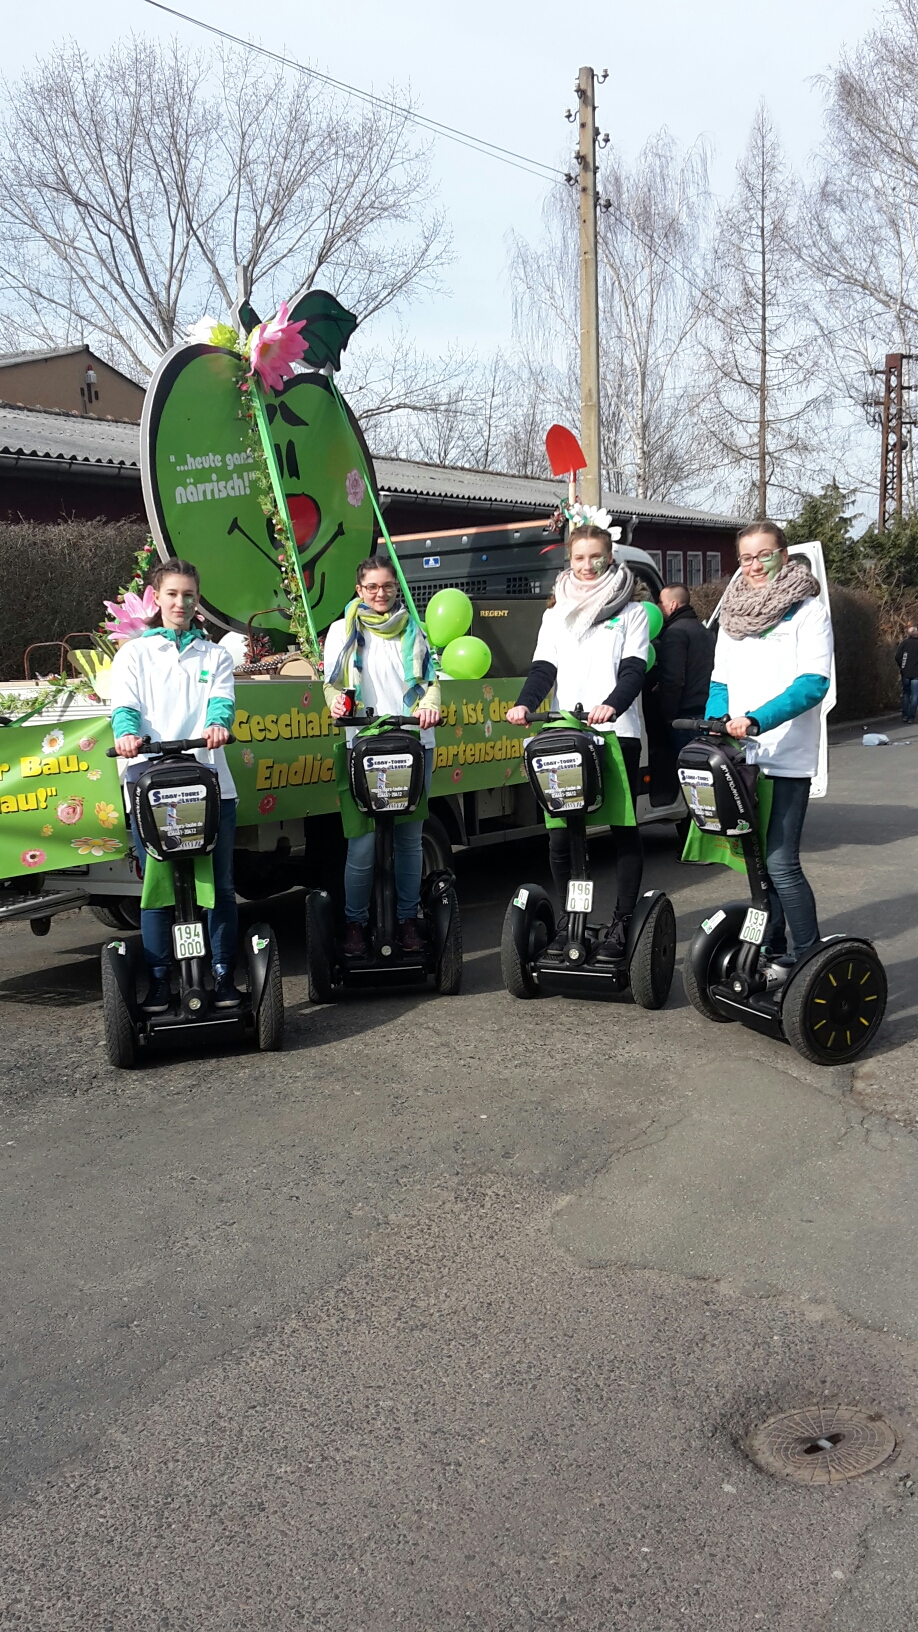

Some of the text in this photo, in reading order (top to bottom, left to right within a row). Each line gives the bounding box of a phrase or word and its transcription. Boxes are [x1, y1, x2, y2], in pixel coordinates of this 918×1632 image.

[175, 471, 256, 504] närrisch!"
[479, 609, 509, 617] REGENT
[462, 698, 485, 725] ist
[20, 755, 89, 778] Bau.
[256, 753, 337, 791] Endlic
[571, 882, 591, 896] 196
[749, 910, 765, 927] 193
[177, 924, 200, 941] 194
[743, 926, 761, 942] 000
[180, 940, 202, 957] 000
